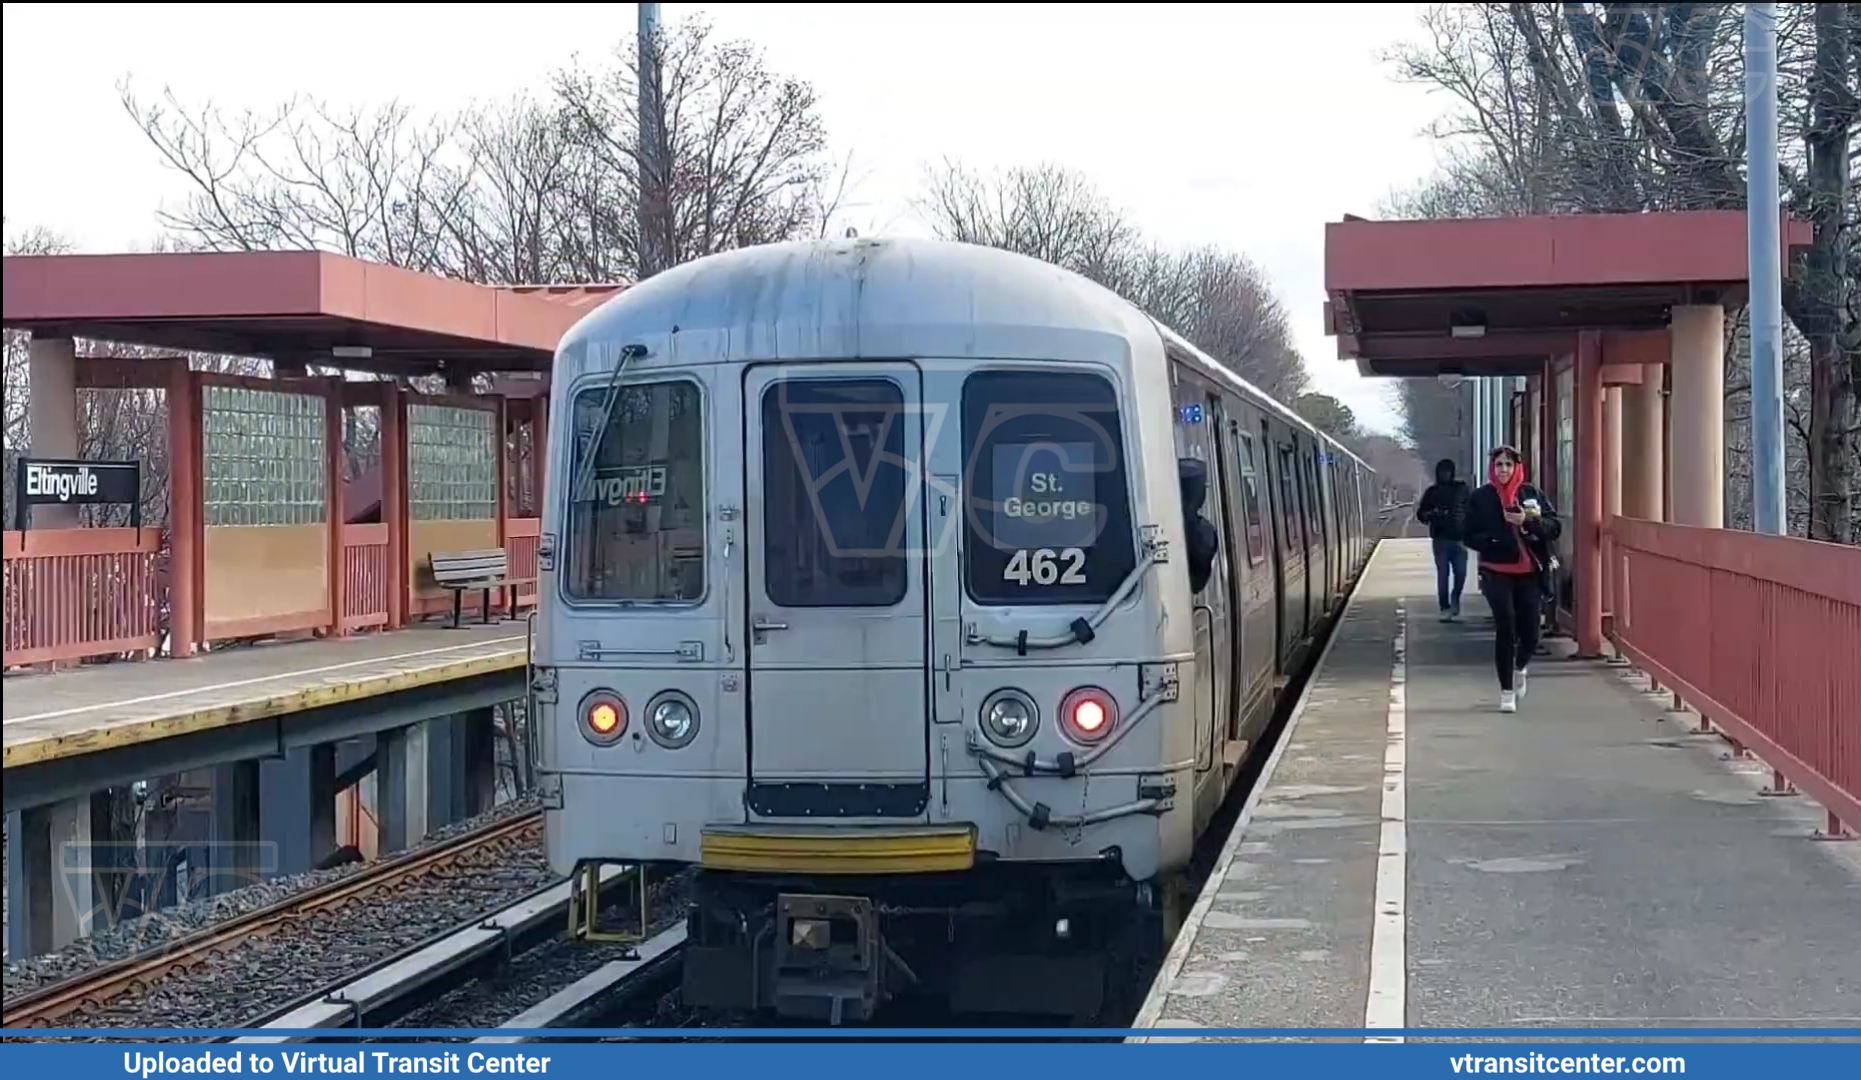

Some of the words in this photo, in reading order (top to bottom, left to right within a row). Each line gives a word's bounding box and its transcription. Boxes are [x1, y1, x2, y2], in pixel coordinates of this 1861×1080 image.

[26, 465, 98, 501] Eltingville
[1031, 472, 1063, 493] St.
[1003, 497, 1092, 520] George
[1003, 548, 1087, 586] 462
